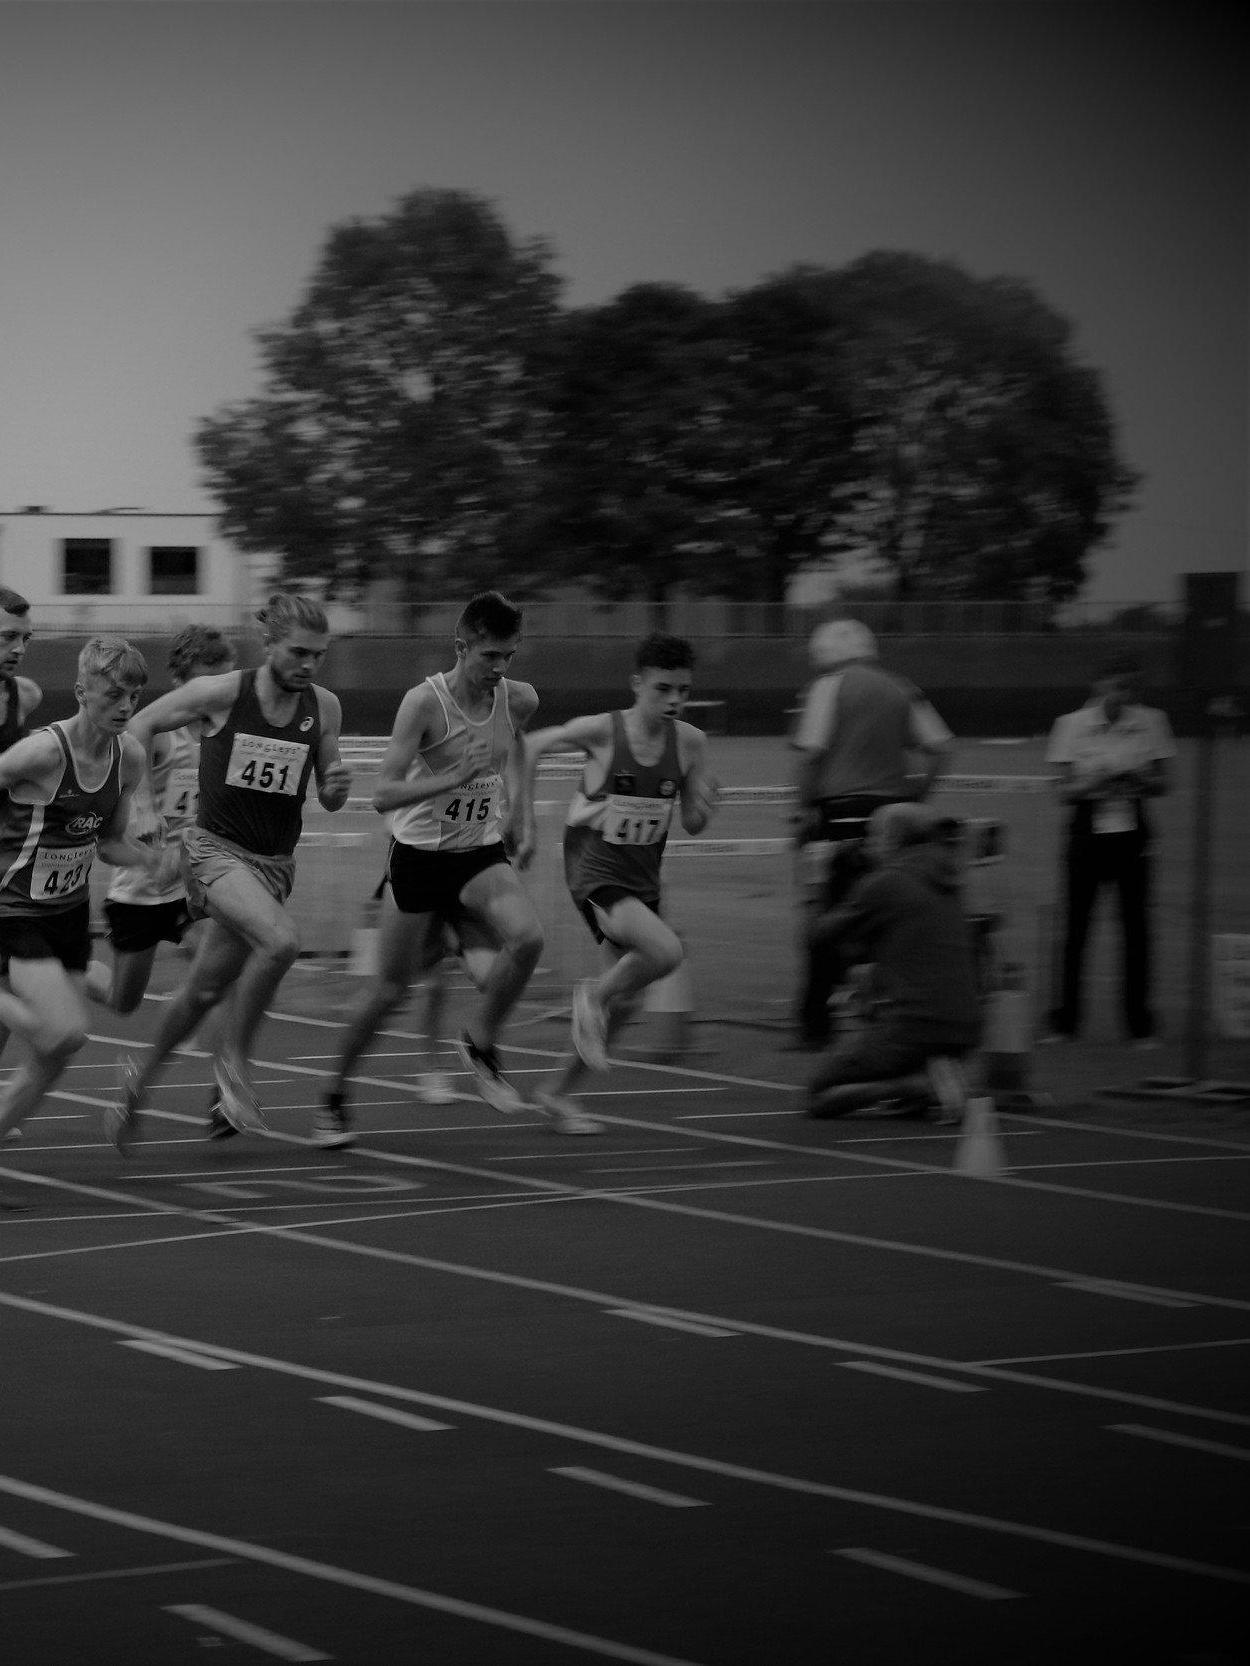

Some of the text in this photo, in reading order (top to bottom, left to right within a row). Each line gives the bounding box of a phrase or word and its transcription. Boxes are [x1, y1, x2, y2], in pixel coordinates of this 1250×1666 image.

[241, 760, 289, 790] 451
[71, 815, 104, 829] RAC
[445, 798, 491, 822] 415
[617, 819, 660, 843] 417
